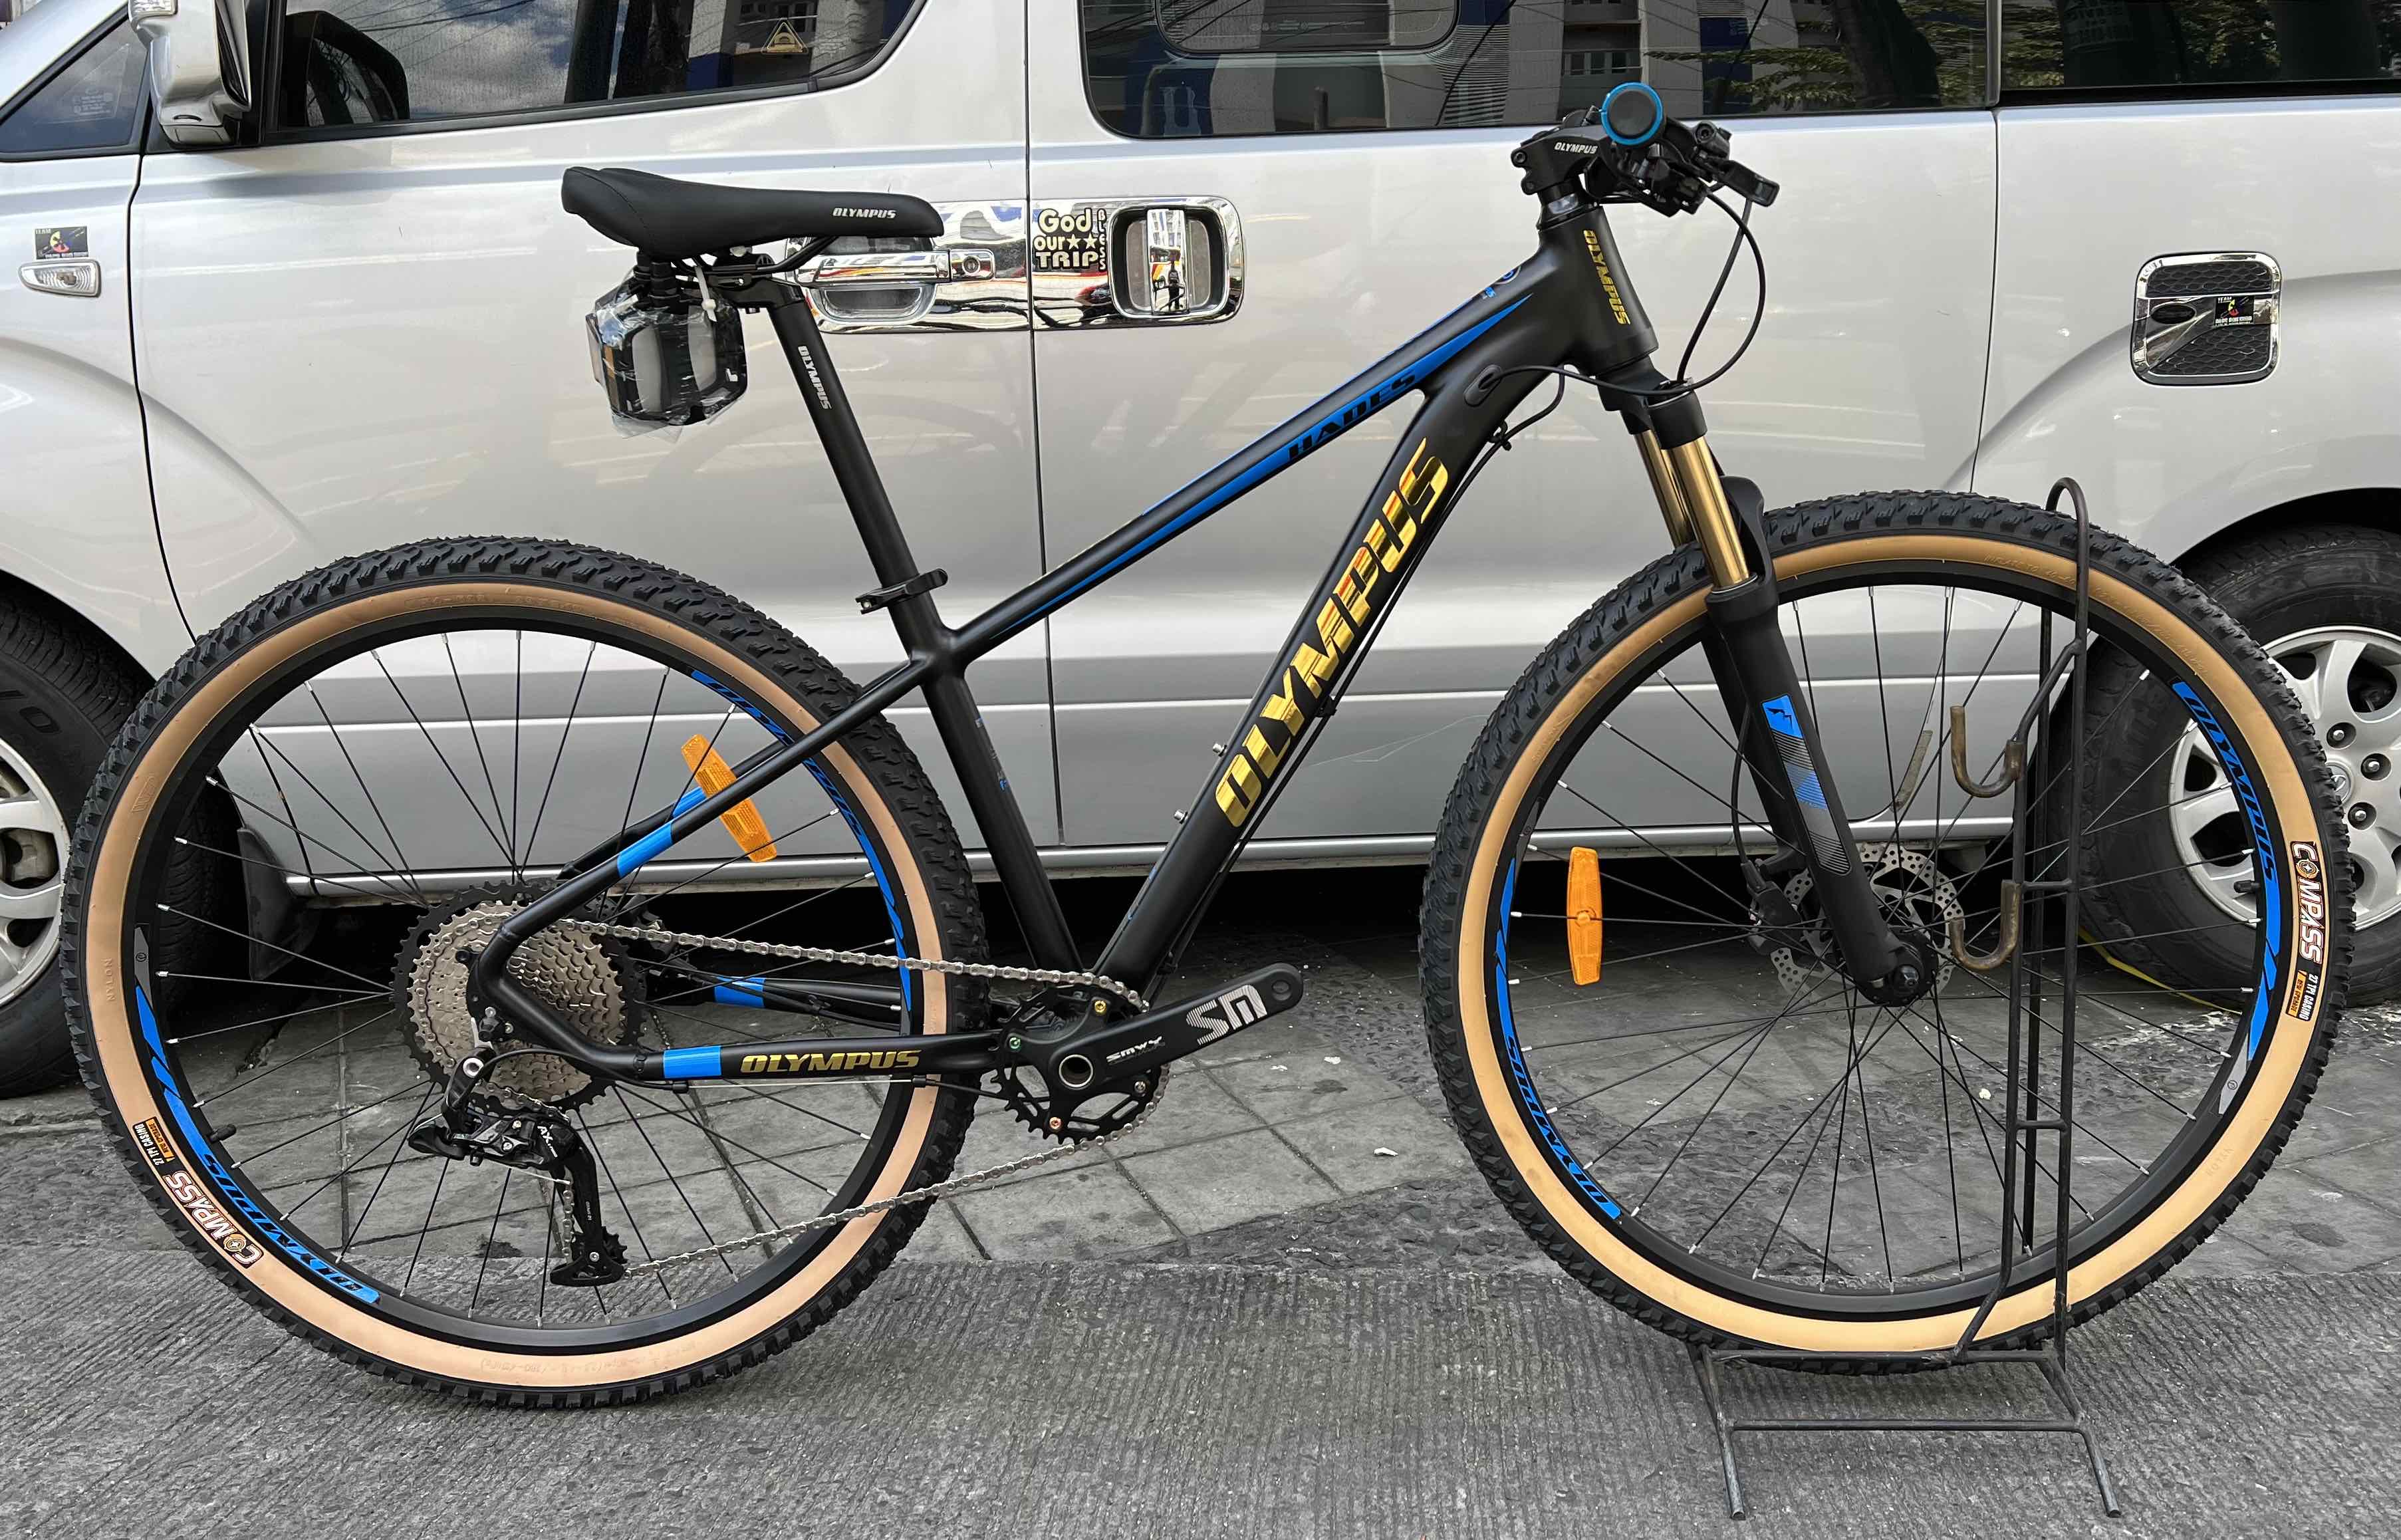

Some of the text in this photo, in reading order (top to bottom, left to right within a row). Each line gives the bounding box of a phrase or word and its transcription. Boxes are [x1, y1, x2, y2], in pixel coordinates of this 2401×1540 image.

[1555, 142, 1598, 154] OLYMPUS
[832, 207, 897, 218] OLYMPUS
[1039, 208, 1092, 233] God
[1033, 235, 1066, 251] our
[1035, 251, 1099, 268] TRIP
[1583, 229, 1631, 324] OLYMPUS
[798, 345, 832, 410] OLYMPUS
[1288, 373, 1416, 460] HADES
[1215, 437, 1449, 828] OLYMPUS
[2183, 696, 2275, 881] OLYMPUS
[2293, 842, 2325, 965] COMPASS
[2305, 983, 2317, 995] TPI
[2307, 973, 2319, 983] 27
[739, 1049, 923, 1073] OLYMPUS
[134, 1123, 164, 1165] 27 TPI CASING
[1507, 1036, 1609, 1204] OLYMPUS
[163, 1170, 264, 1265] COMPASS
[204, 1154, 363, 1291] OLYMPUS
